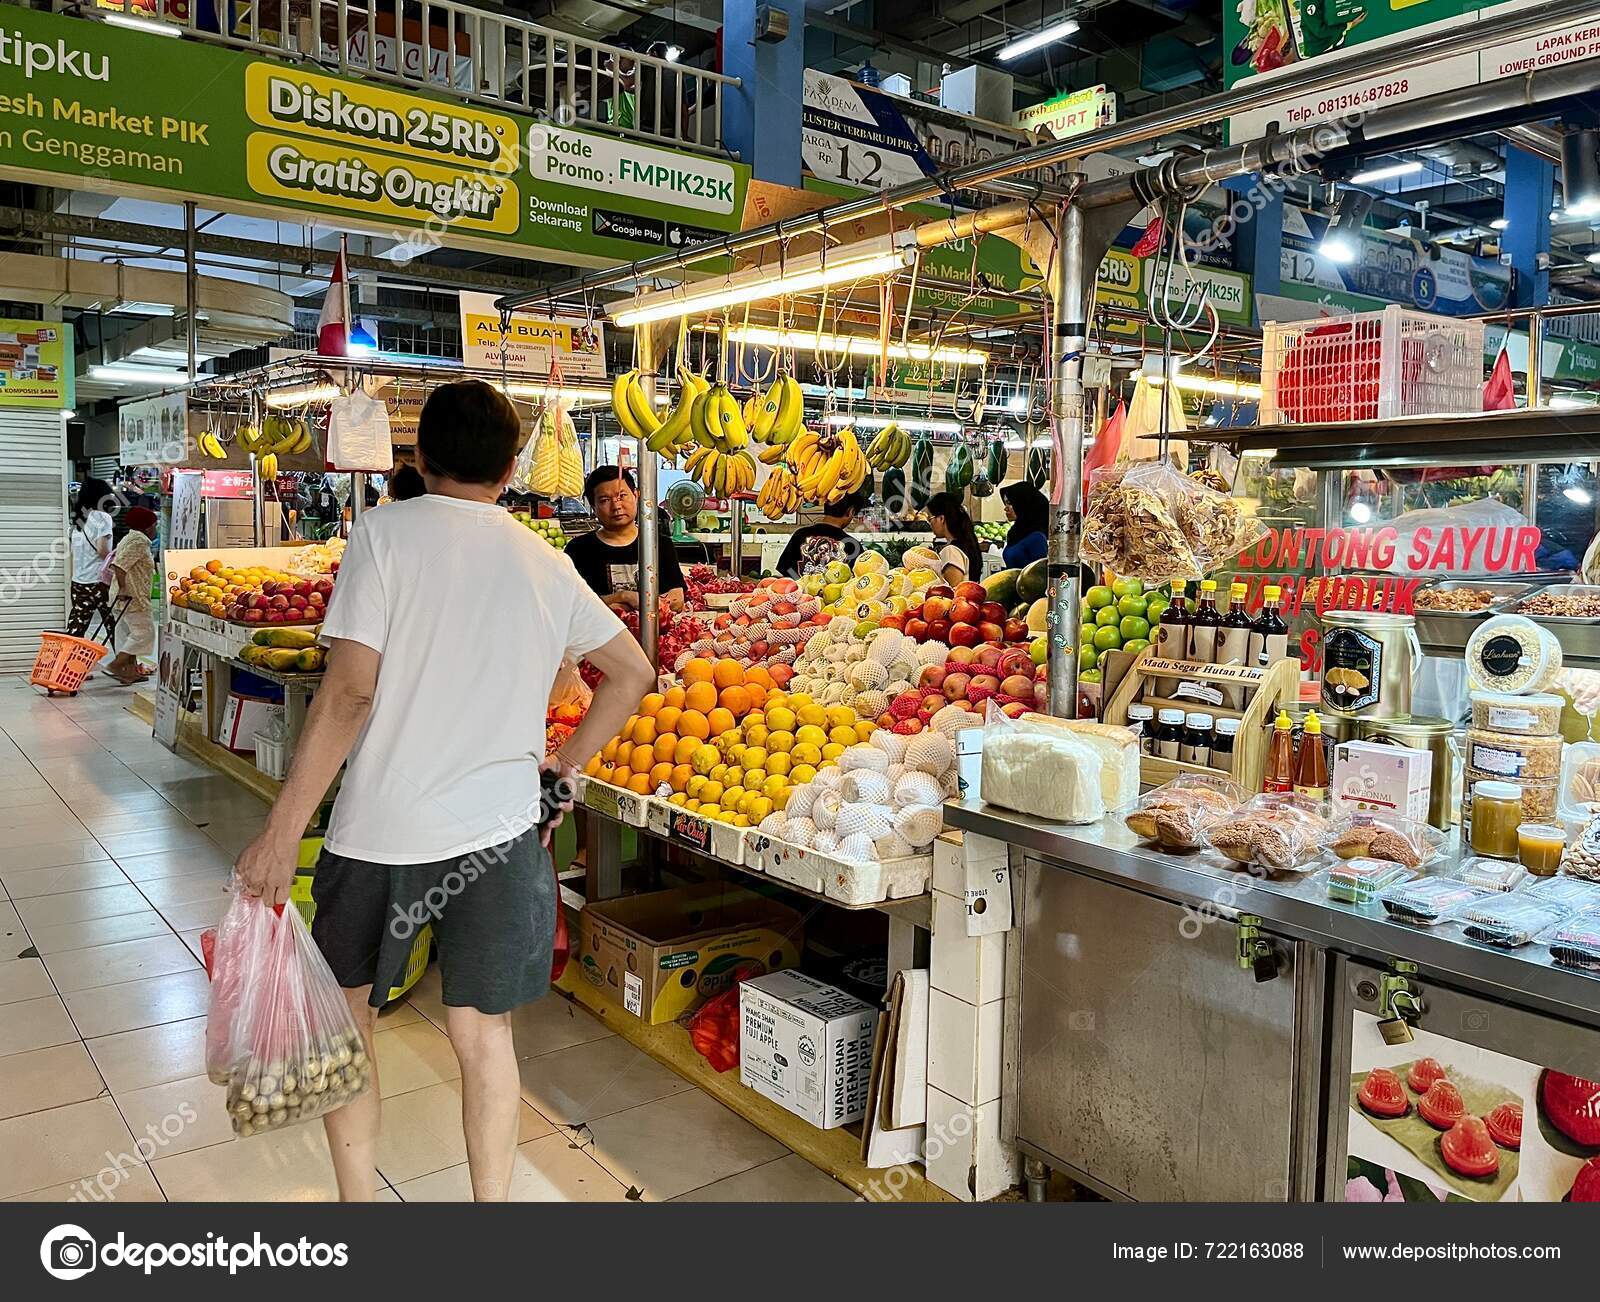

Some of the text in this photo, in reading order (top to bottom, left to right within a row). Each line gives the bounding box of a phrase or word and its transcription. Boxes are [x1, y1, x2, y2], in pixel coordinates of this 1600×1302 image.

[1536, 33, 1572, 51] LAPAK
[1499, 58, 1536, 75] LOWER
[1538, 46, 1586, 66] GROUND
[269, 78, 399, 137] Diskon
[1287, 80, 1409, 123] Telp. 081316687828
[54, 98, 153, 137] Market
[162, 117, 209, 146] PIK
[547, 133, 593, 158] Kode
[840, 123, 885, 144] TERBARU
[886, 136, 896, 147] DI
[897, 139, 912, 151] PIK
[913, 143, 919, 152] 2
[22, 129, 184, 174] Genggaman
[818, 151, 834, 165] Rp.
[269, 147, 378, 194] Gratis
[547, 156, 604, 183] Promo
[619, 158, 734, 203] FMPIK25K
[530, 196, 588, 217] Download
[529, 211, 582, 232] Sekarang
[612, 223, 663, 242] Google Play
[477, 338, 498, 348] Telp.
[518, 326, 563, 339] BUAH
[1407, 525, 1541, 573] SAYUR
[1315, 576, 1422, 617] UDUK
[1141, 658, 1264, 680] Madu Segar Hutan Liar
[745, 1006, 761, 1019] WANG
[762, 1013, 776, 1026] SHAN
[745, 1014, 773, 1037] PREMIUM
[745, 1026, 779, 1051] FUJI APPLE
[834, 1037, 845, 1120] WANG SHAN
[846, 1039, 860, 1115] PREMIUM
